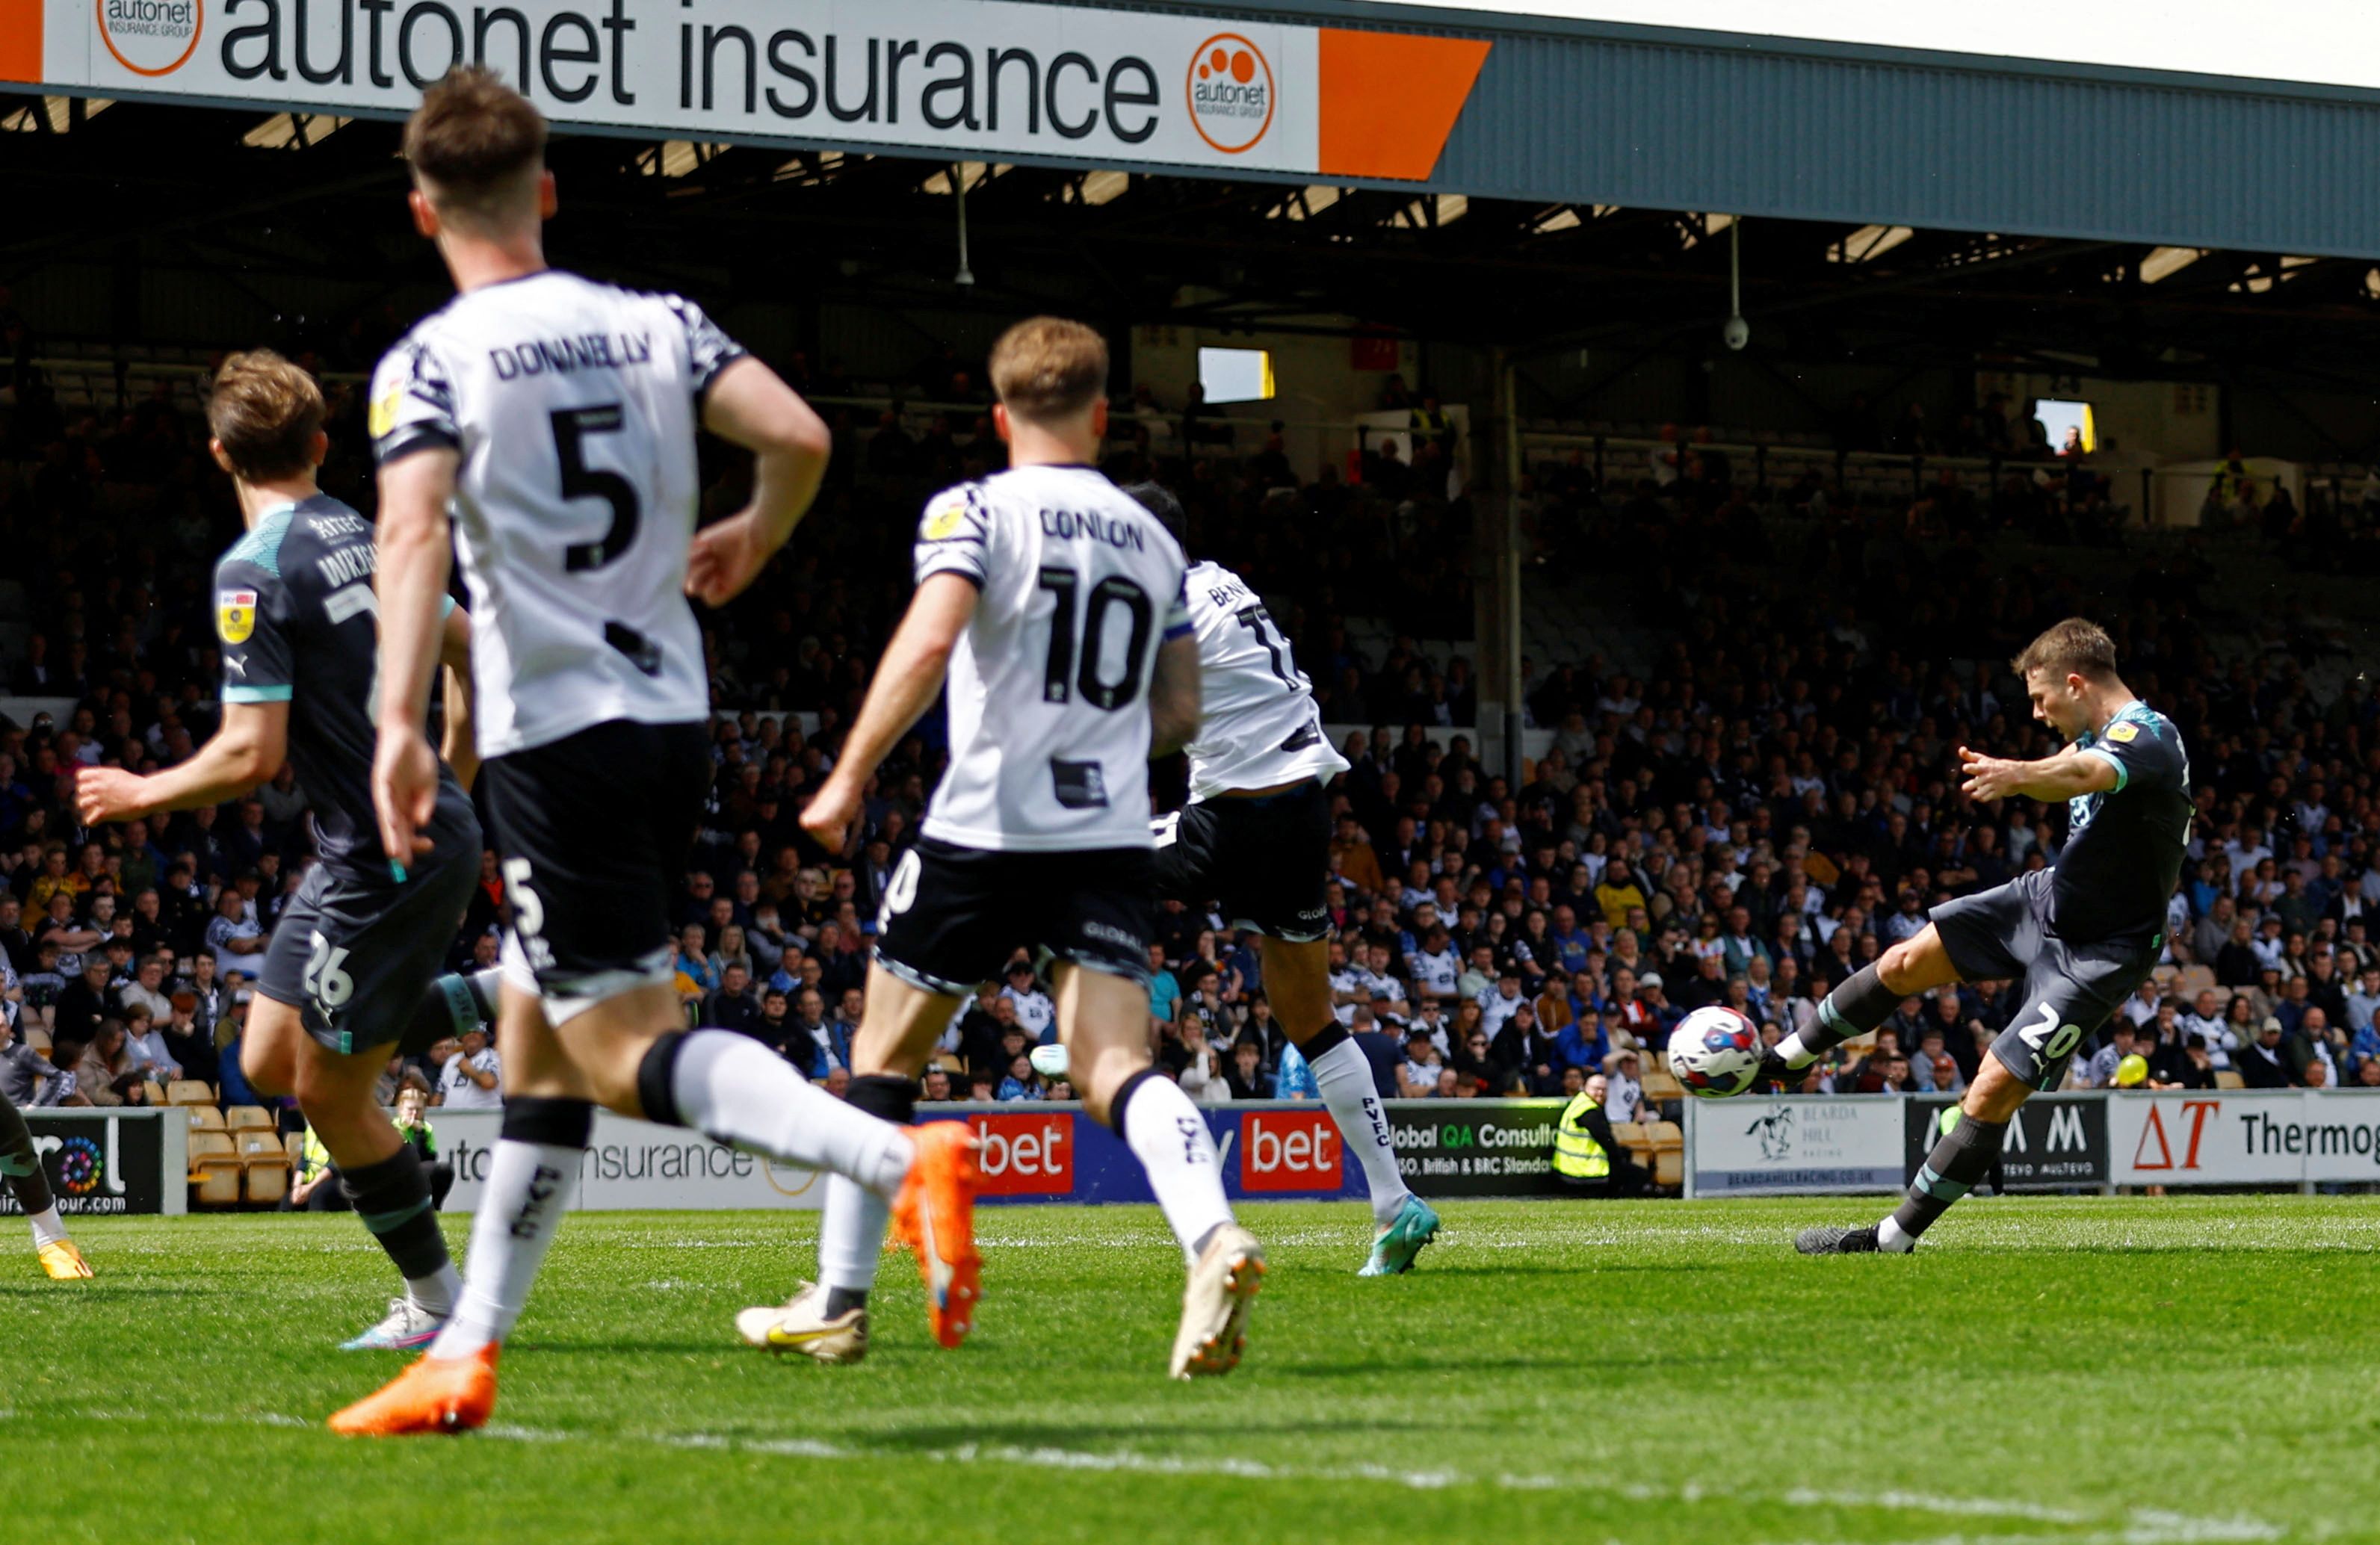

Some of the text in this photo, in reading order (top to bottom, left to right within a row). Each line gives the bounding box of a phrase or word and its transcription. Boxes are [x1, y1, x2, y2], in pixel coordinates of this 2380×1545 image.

[108, 0, 192, 24] autonet
[109, 20, 193, 37] INSURANCE GROUP
[221, 0, 1161, 143] autonet insurance
[1196, 79, 1265, 105] autonet
[489, 332, 649, 380] DONNELLY
[550, 404, 642, 573] 5
[1040, 509, 1144, 553] CONLON
[1039, 566, 1154, 713] 10
[501, 857, 544, 937] 5
[306, 929, 354, 1006] 26
[2018, 1002, 2081, 1059] 20
[1252, 1118, 1332, 1172] bet
[1362, 1097, 1390, 1147] PVFC
[1389, 1124, 1438, 1148] lobal
[1442, 1124, 1474, 1148] QA
[579, 1142, 753, 1180] nsurance
[979, 1121, 1063, 1175] bet
[1422, 1157, 1459, 1176] British
[1461, 1158, 1472, 1175] &
[1502, 1156, 1552, 1174] Standa
